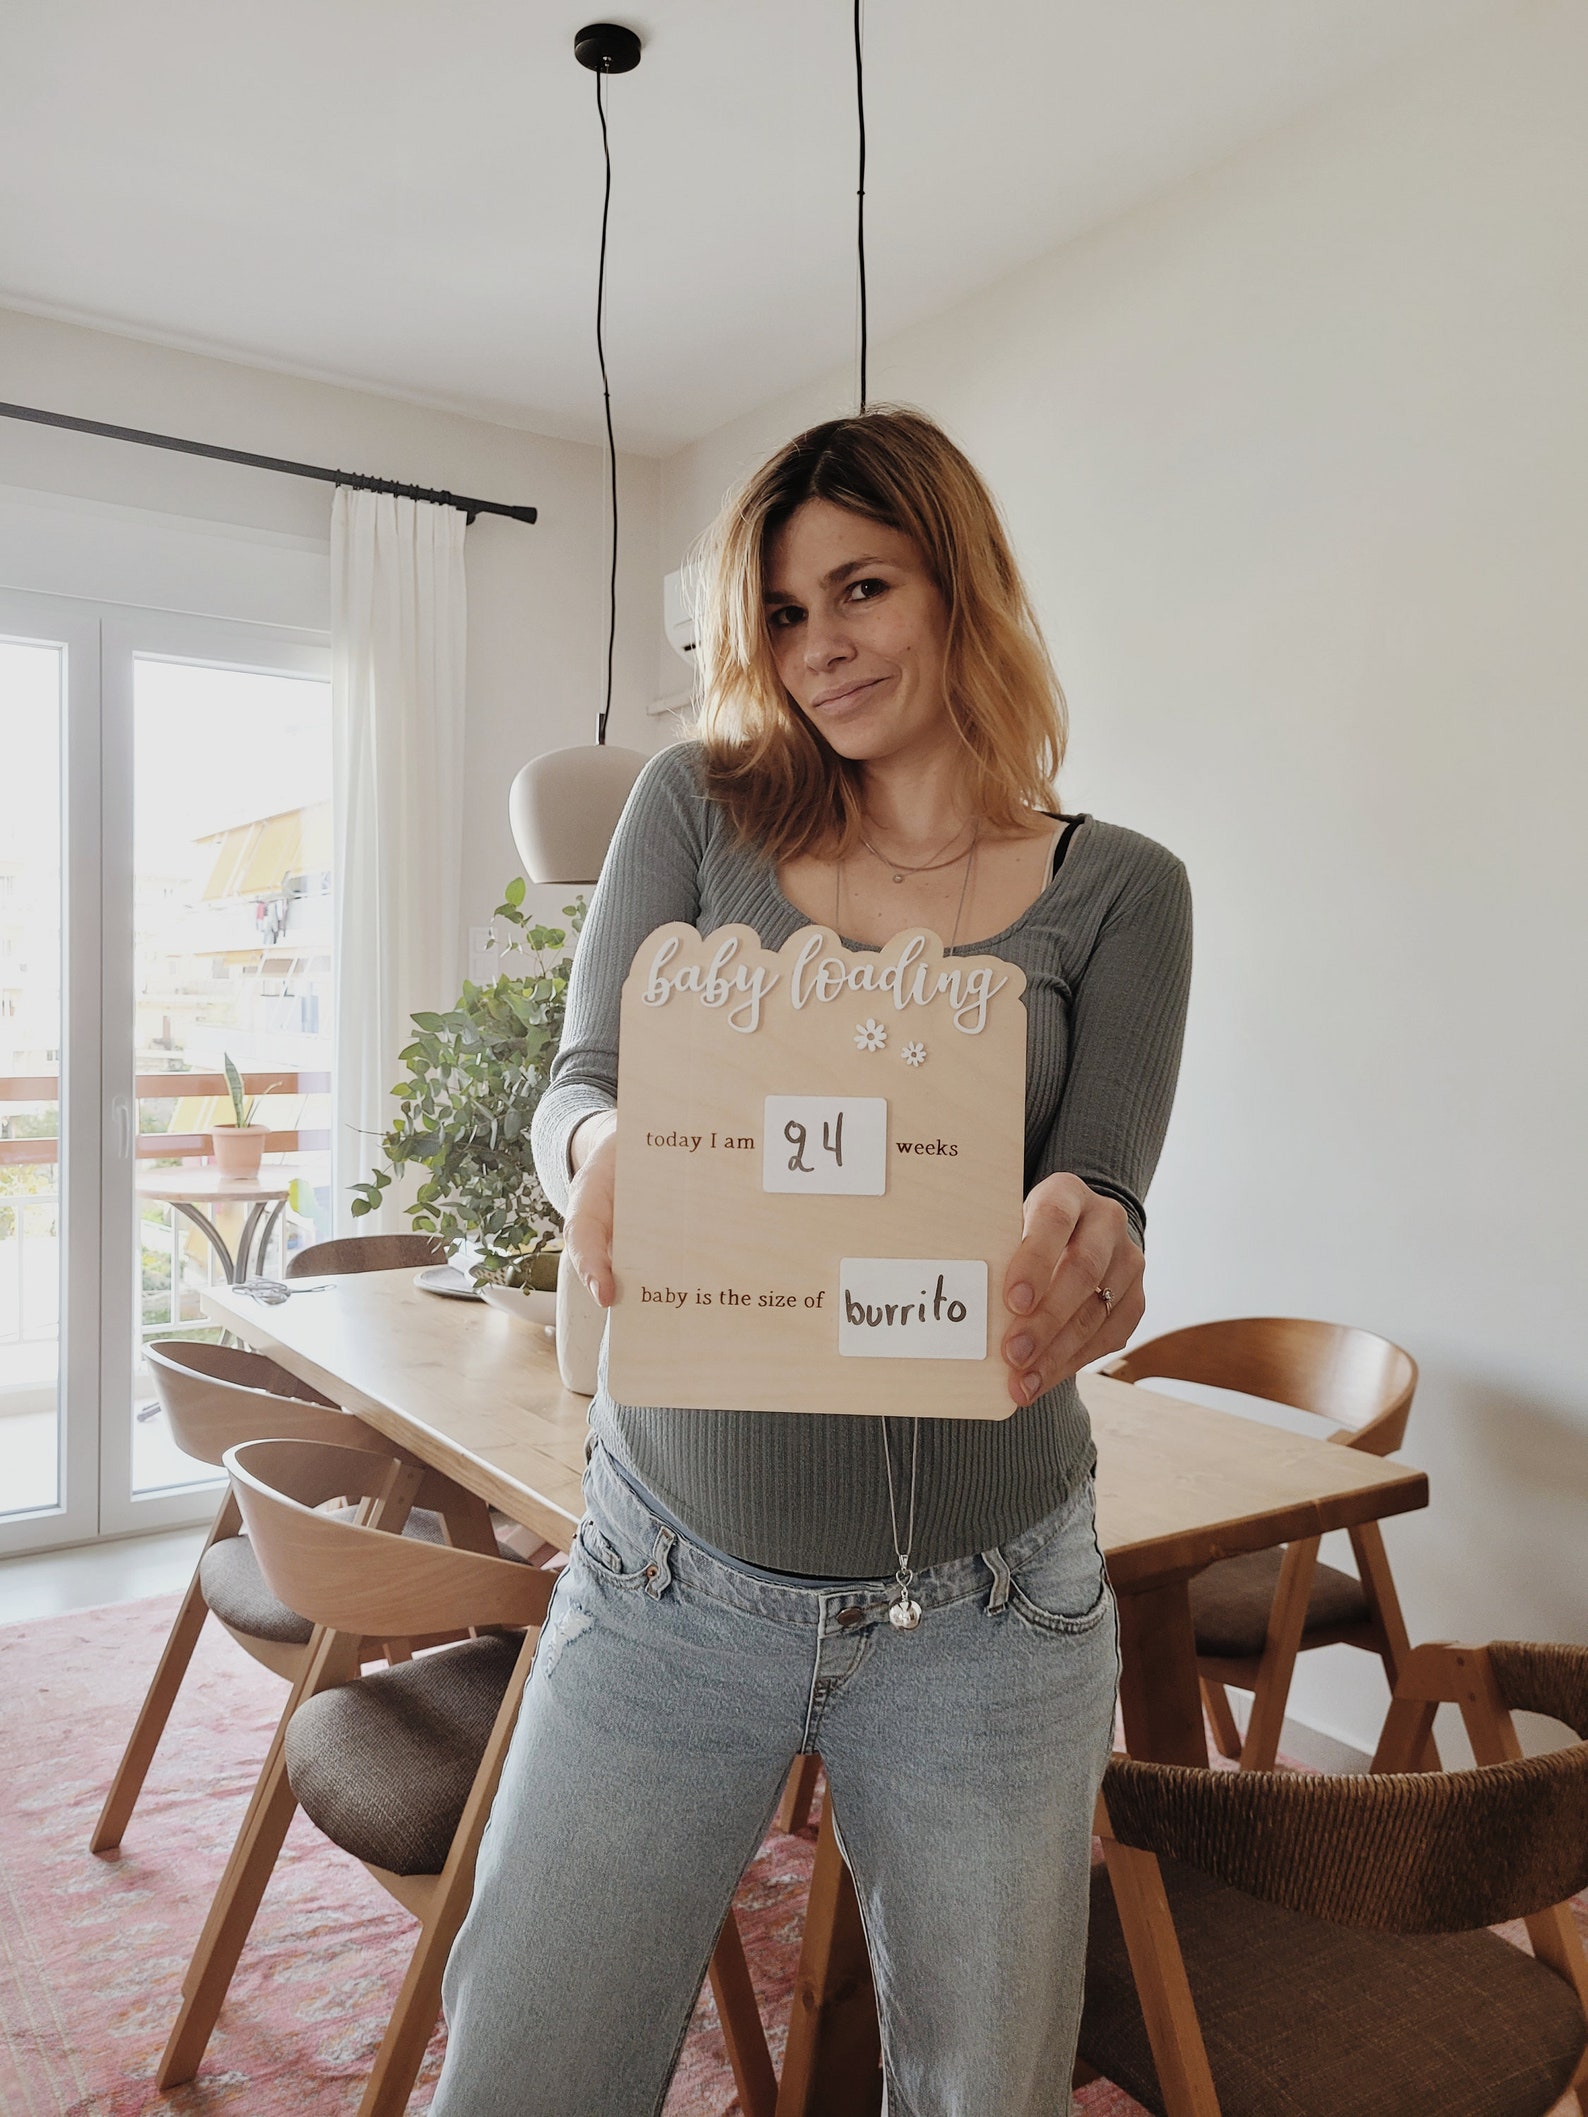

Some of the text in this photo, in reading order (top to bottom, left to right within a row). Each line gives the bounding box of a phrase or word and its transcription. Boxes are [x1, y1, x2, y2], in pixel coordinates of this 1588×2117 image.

[641, 933, 1009, 1036] baby loading
[645, 1131, 755, 1151] today I am
[783, 1111, 844, 1173] 24
[896, 1138, 959, 1157] weeks
[640, 1286, 825, 1309] baby is the size of
[845, 1274, 967, 1328] burrito
